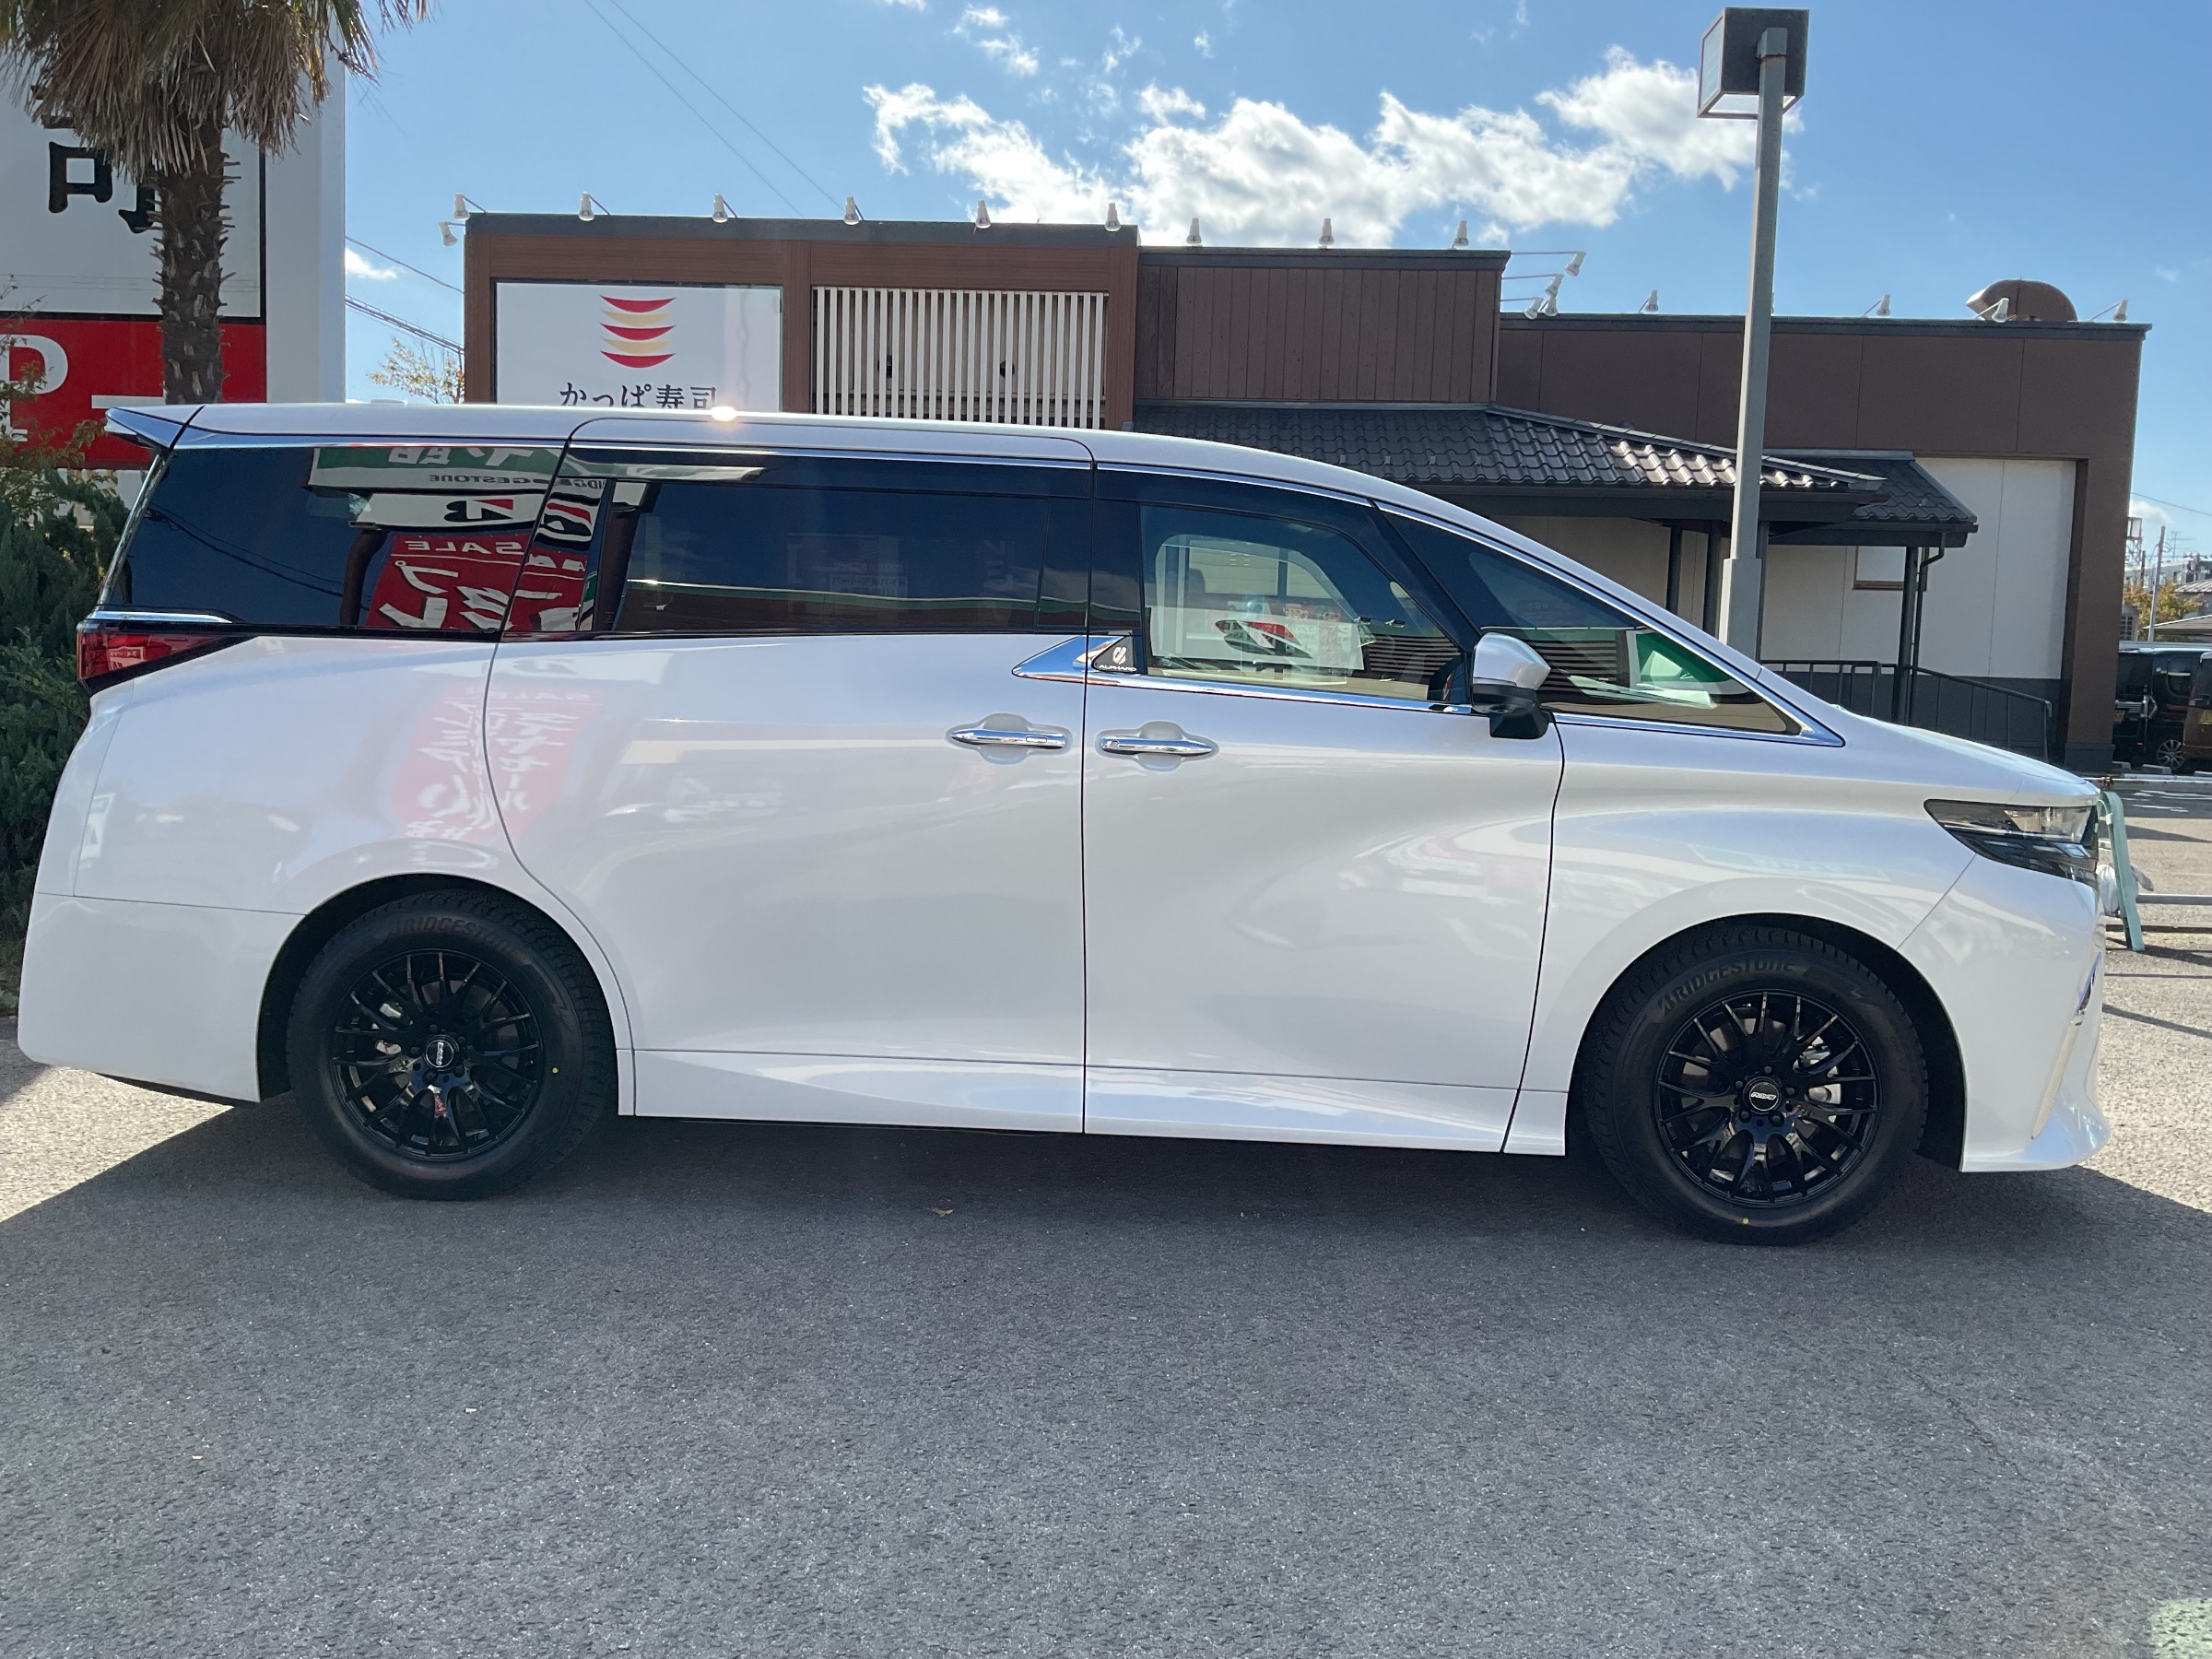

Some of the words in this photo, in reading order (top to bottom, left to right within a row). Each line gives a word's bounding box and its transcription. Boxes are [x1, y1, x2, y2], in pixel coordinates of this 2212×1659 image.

[559, 382, 717, 409] かっぱ寿司
[1657, 958, 1798, 1017] BRIDGESTONE
